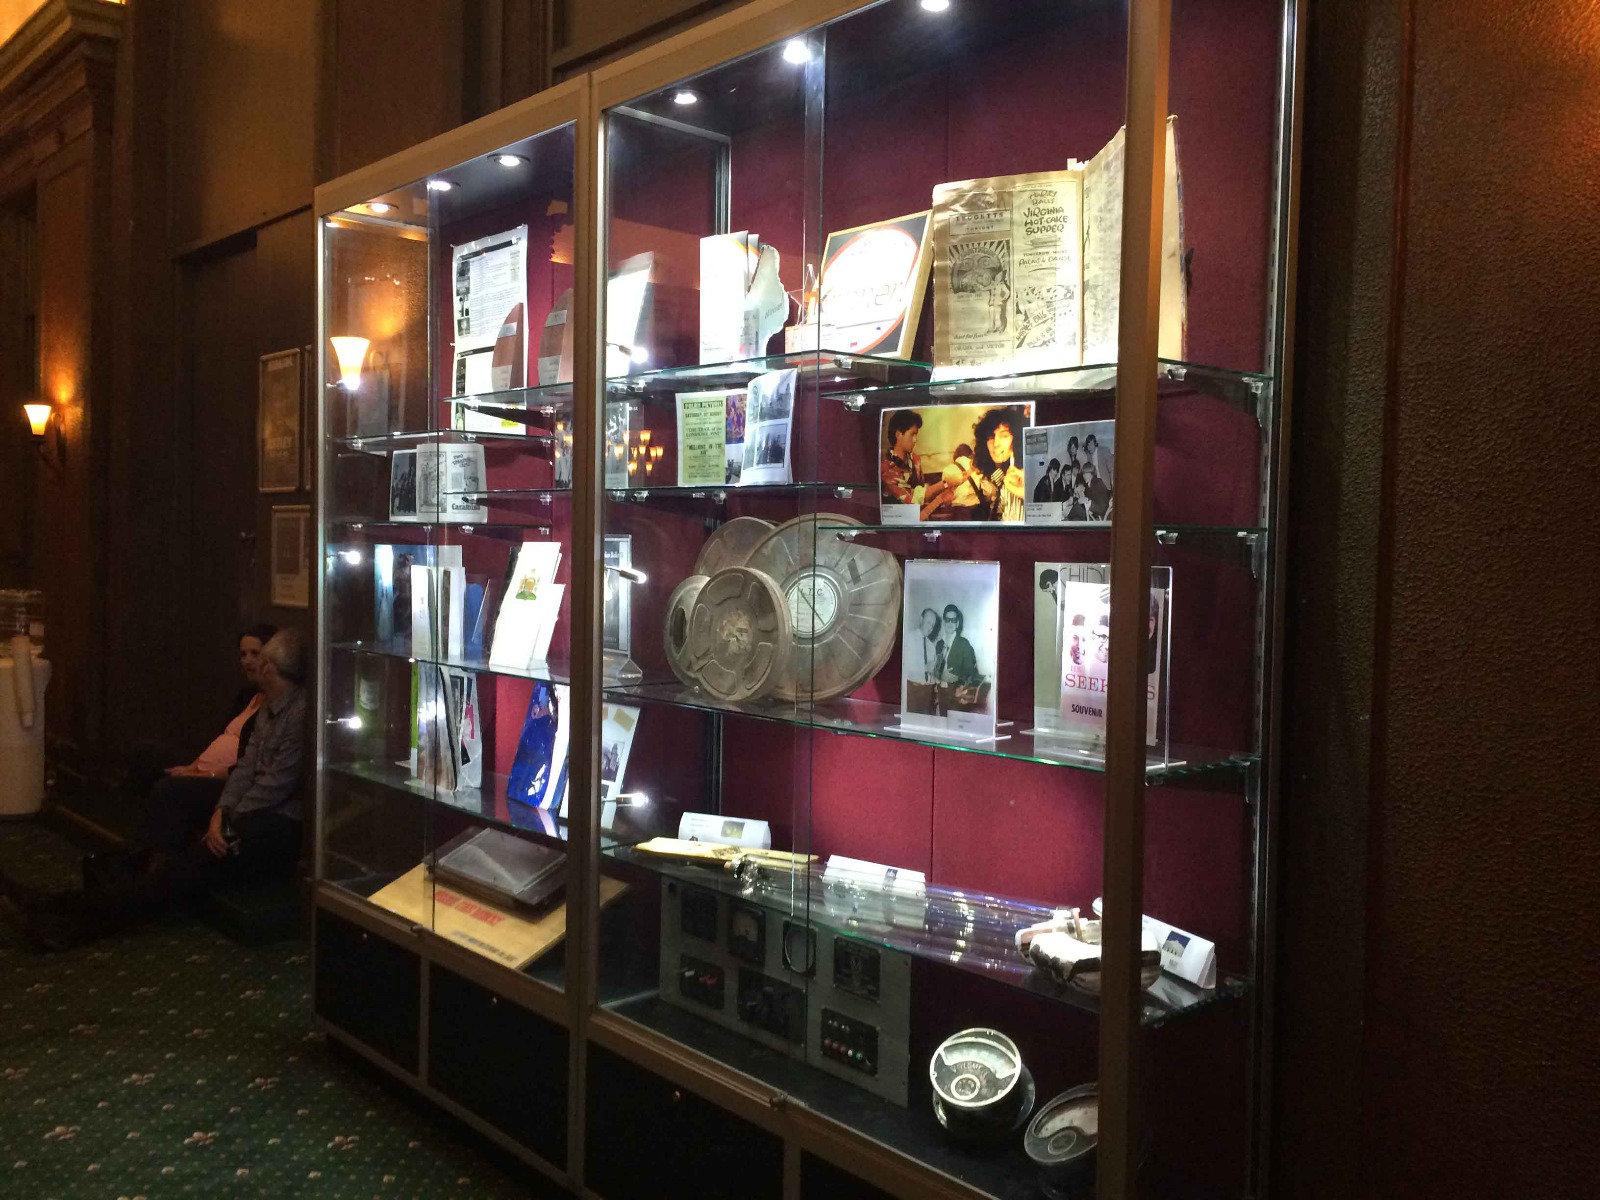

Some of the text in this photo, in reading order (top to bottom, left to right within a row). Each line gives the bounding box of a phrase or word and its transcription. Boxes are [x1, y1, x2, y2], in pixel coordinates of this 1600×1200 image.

[1023, 206, 1064, 218] VIRGINIA
[1025, 225, 1065, 235] SUPPER
[1071, 703, 1103, 718] SOUVENIR
